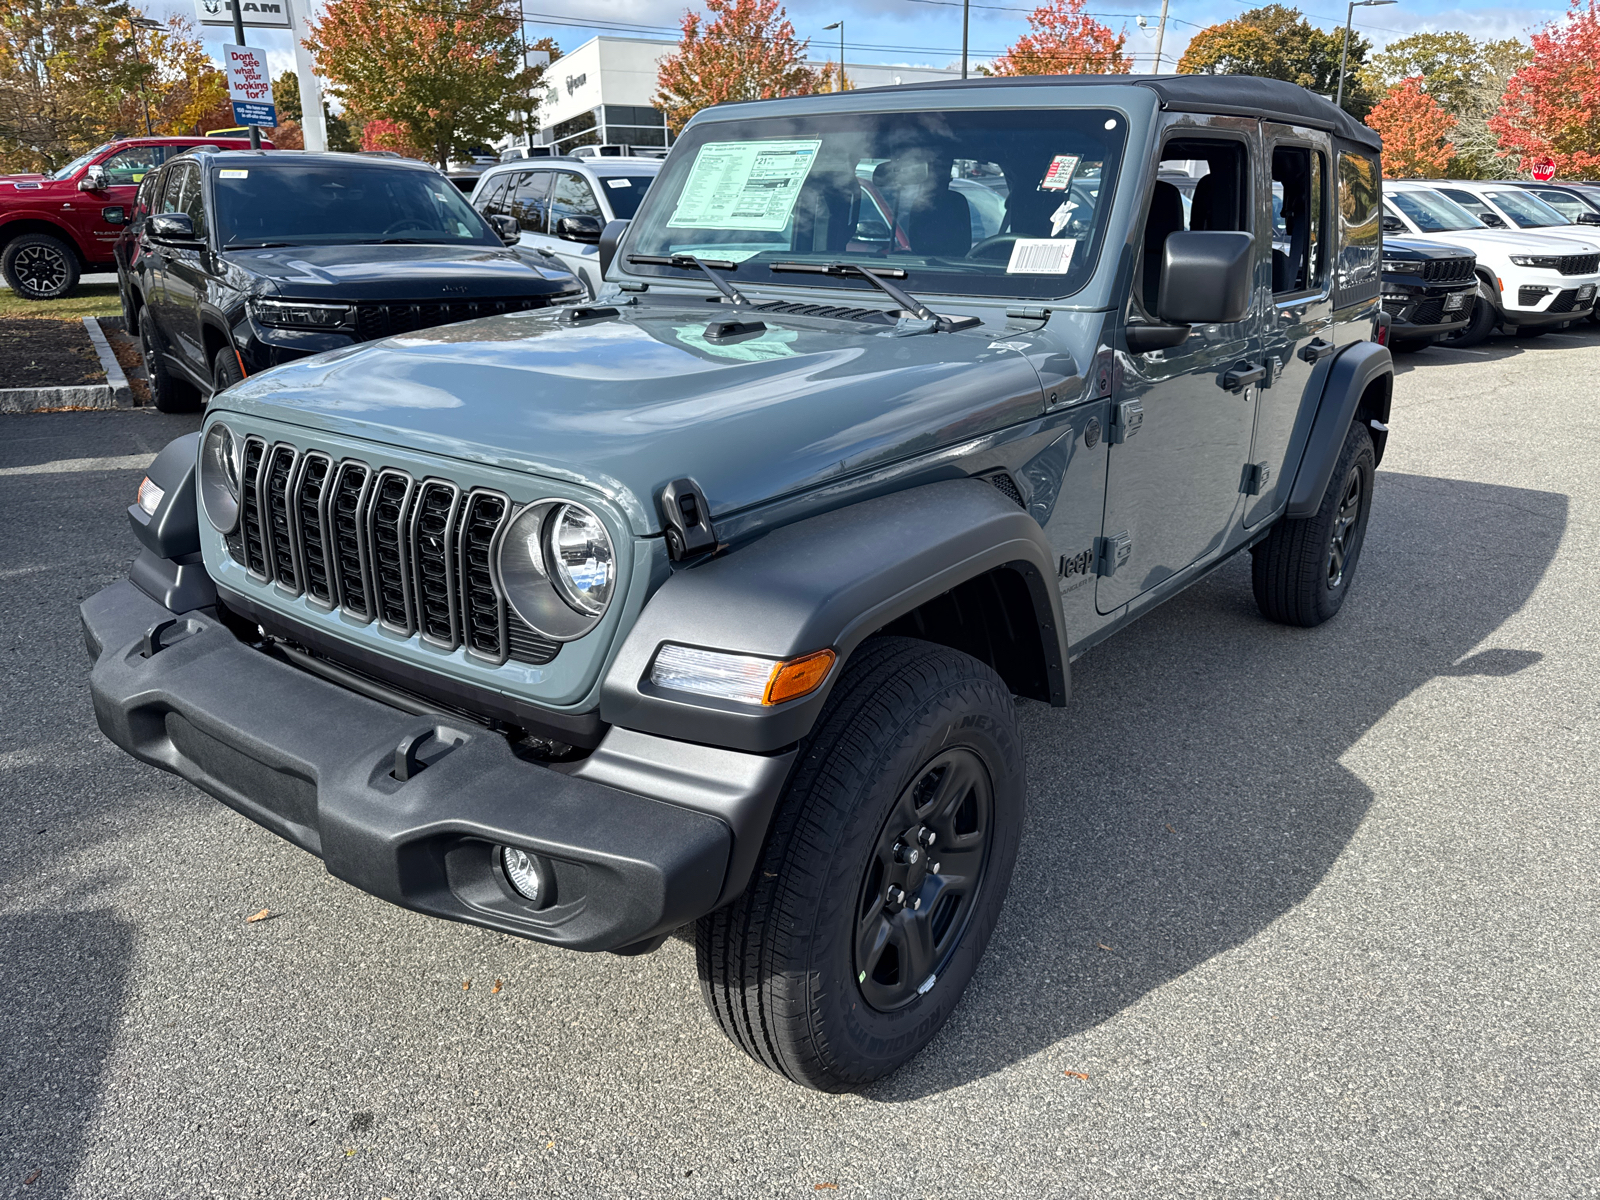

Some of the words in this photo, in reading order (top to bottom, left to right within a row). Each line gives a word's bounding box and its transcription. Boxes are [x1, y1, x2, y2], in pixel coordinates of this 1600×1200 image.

[231, 52, 254, 60] Dont
[233, 67, 256, 75] what
[243, 73, 262, 82] your
[234, 81, 269, 91] looking
[245, 90, 265, 99] for?
[1533, 164, 1554, 175] STOP
[1057, 548, 1095, 581] Jeep
